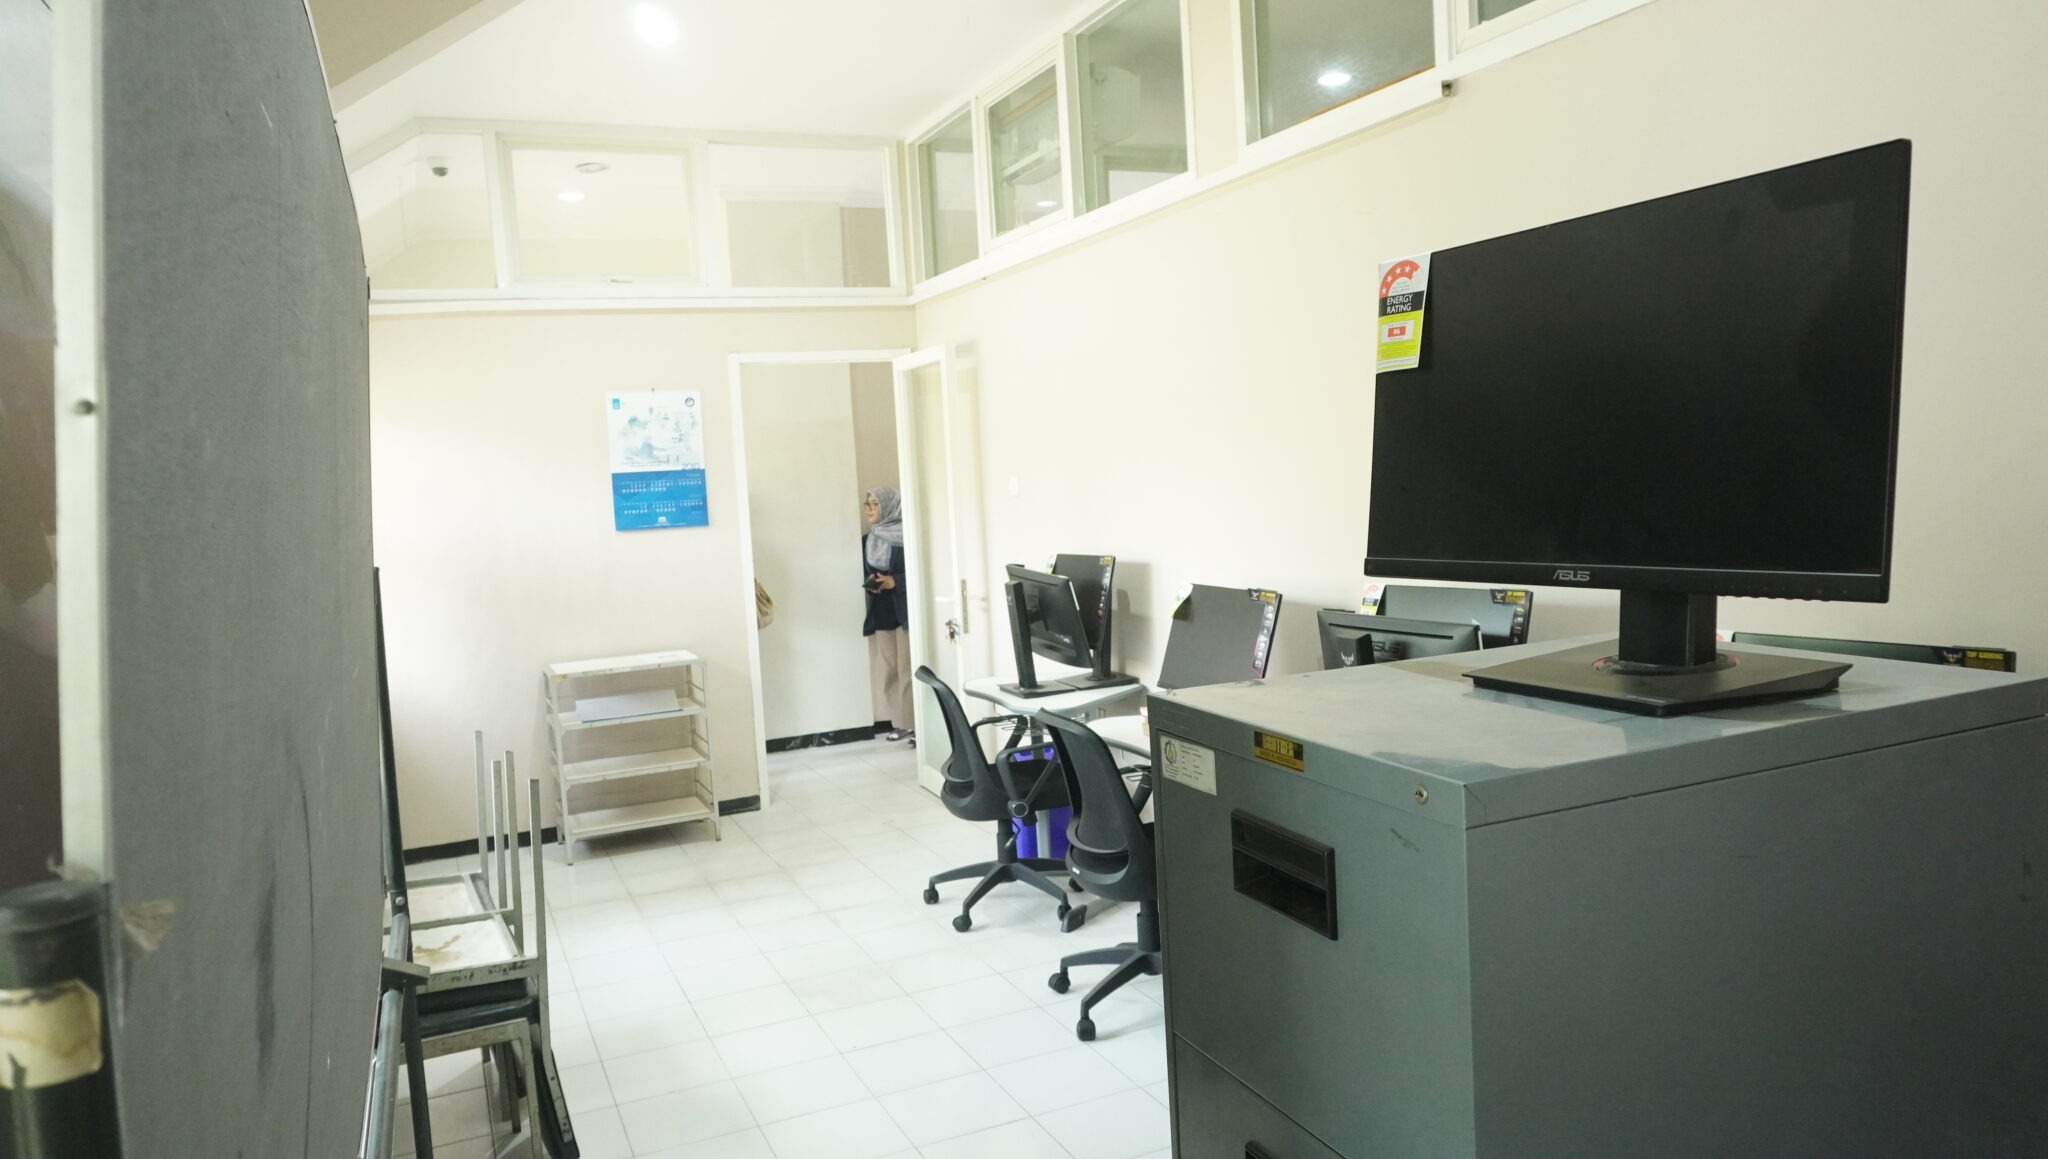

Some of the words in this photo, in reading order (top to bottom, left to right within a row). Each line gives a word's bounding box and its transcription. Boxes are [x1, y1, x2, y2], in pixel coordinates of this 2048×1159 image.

[1386, 294, 1413, 305] ENERGY
[1386, 303, 1412, 314] RATING
[1552, 569, 1591, 581] ASUS
